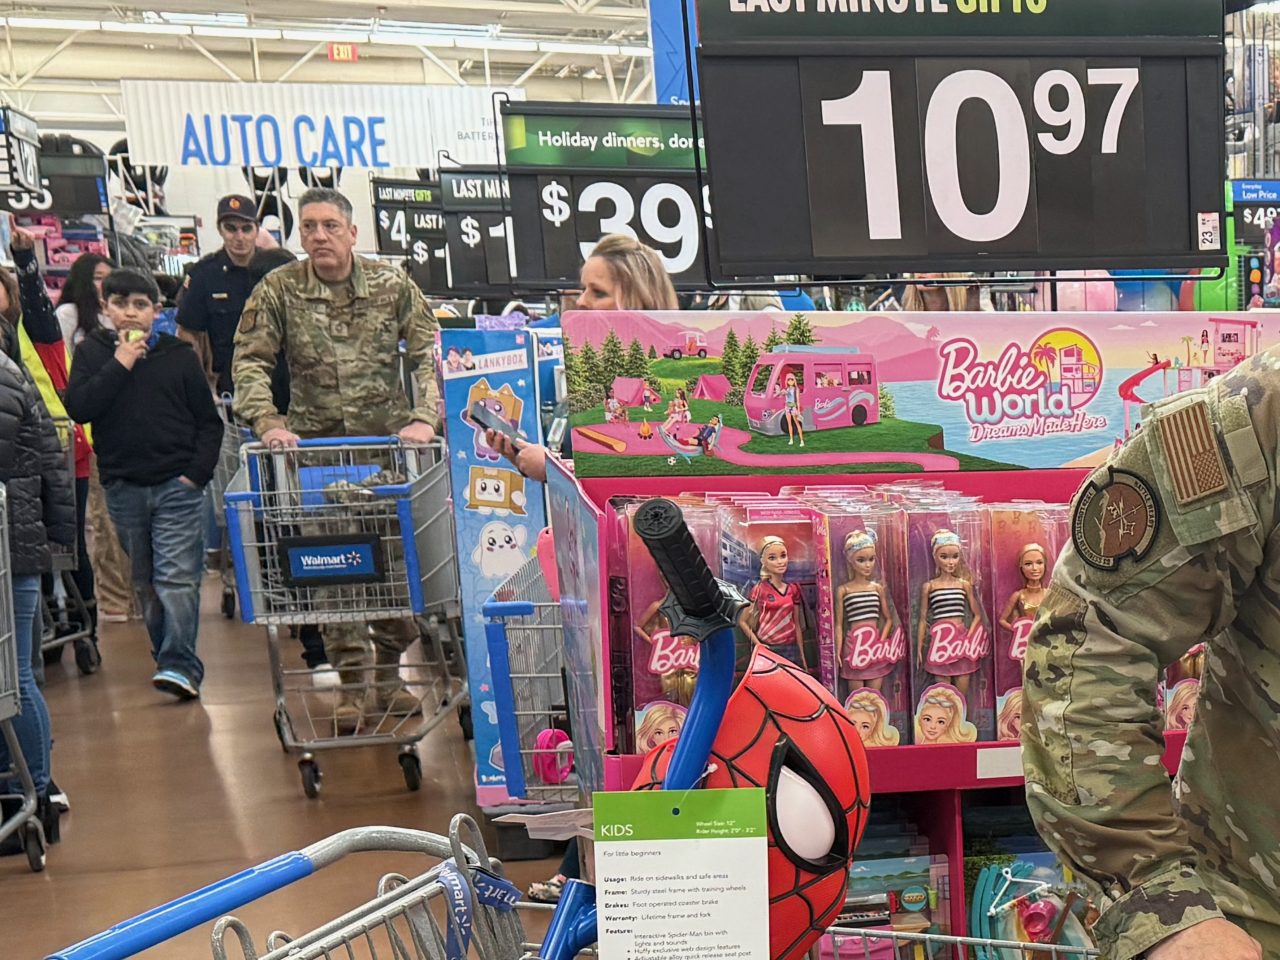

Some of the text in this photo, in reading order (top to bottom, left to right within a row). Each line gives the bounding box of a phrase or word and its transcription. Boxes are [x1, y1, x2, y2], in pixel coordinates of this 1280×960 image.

[181, 113, 390, 168] AUTO CARE
[538, 131, 664, 151] Holiday dinners,
[378, 187, 392, 200] LAST
[451, 179, 482, 199] LAST
[1242, 191, 1278, 199] Low Price
[414, 213, 437, 229] LAST
[541, 180, 708, 275] $39
[1201, 231, 1214, 244] 23
[478, 354, 523, 370] LANKYBOX
[940, 340, 1047, 399] Barbie
[965, 385, 1073, 424] World
[300, 554, 346, 566] Walmart
[600, 824, 633, 837] KIDS
[631, 850, 661, 858] beginners
[604, 876, 627, 884] Usage:
[631, 888, 651, 896] Sturdy
[701, 886, 724, 894] training
[648, 900, 676, 908] operated
[605, 915, 637, 923] Warranty:
[634, 932, 666, 940] Interactive
[634, 940, 651, 948] lights
[635, 947, 651, 955] Huffy
[653, 946, 680, 954] exclusive
[695, 945, 716, 954] design
[684, 953, 700, 960] quick
[701, 952, 723, 960] release
[738, 951, 751, 959] post
